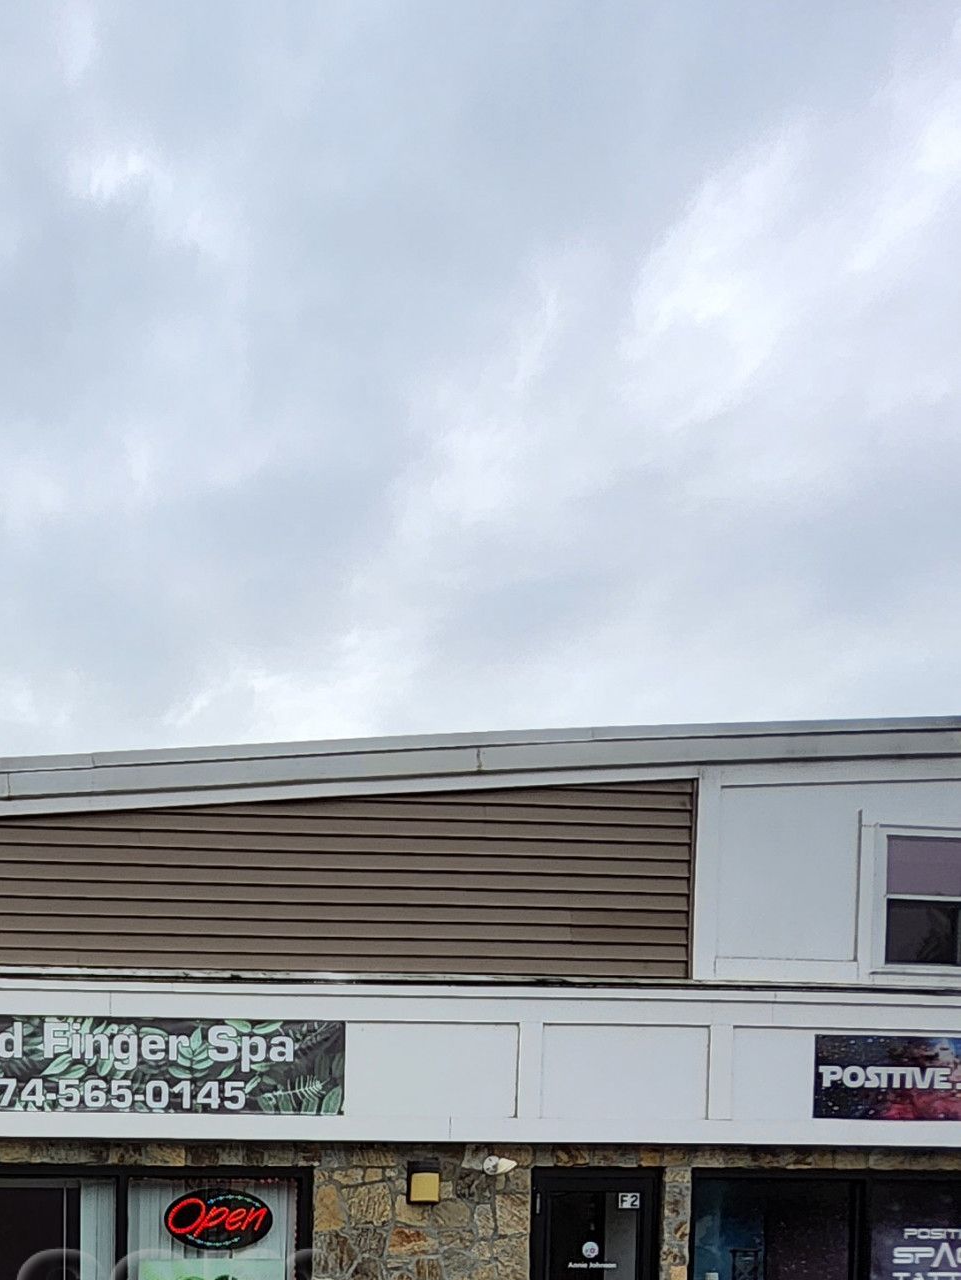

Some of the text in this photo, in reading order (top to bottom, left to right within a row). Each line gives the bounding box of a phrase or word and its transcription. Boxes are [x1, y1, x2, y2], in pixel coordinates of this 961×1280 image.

[43, 1021, 190, 1070] Finger
[207, 1025, 294, 1072] Spa
[819, 1065, 952, 1089] POSITIVE
[620, 1194, 638, 1207] F2
[168, 1198, 267, 1237] Open
